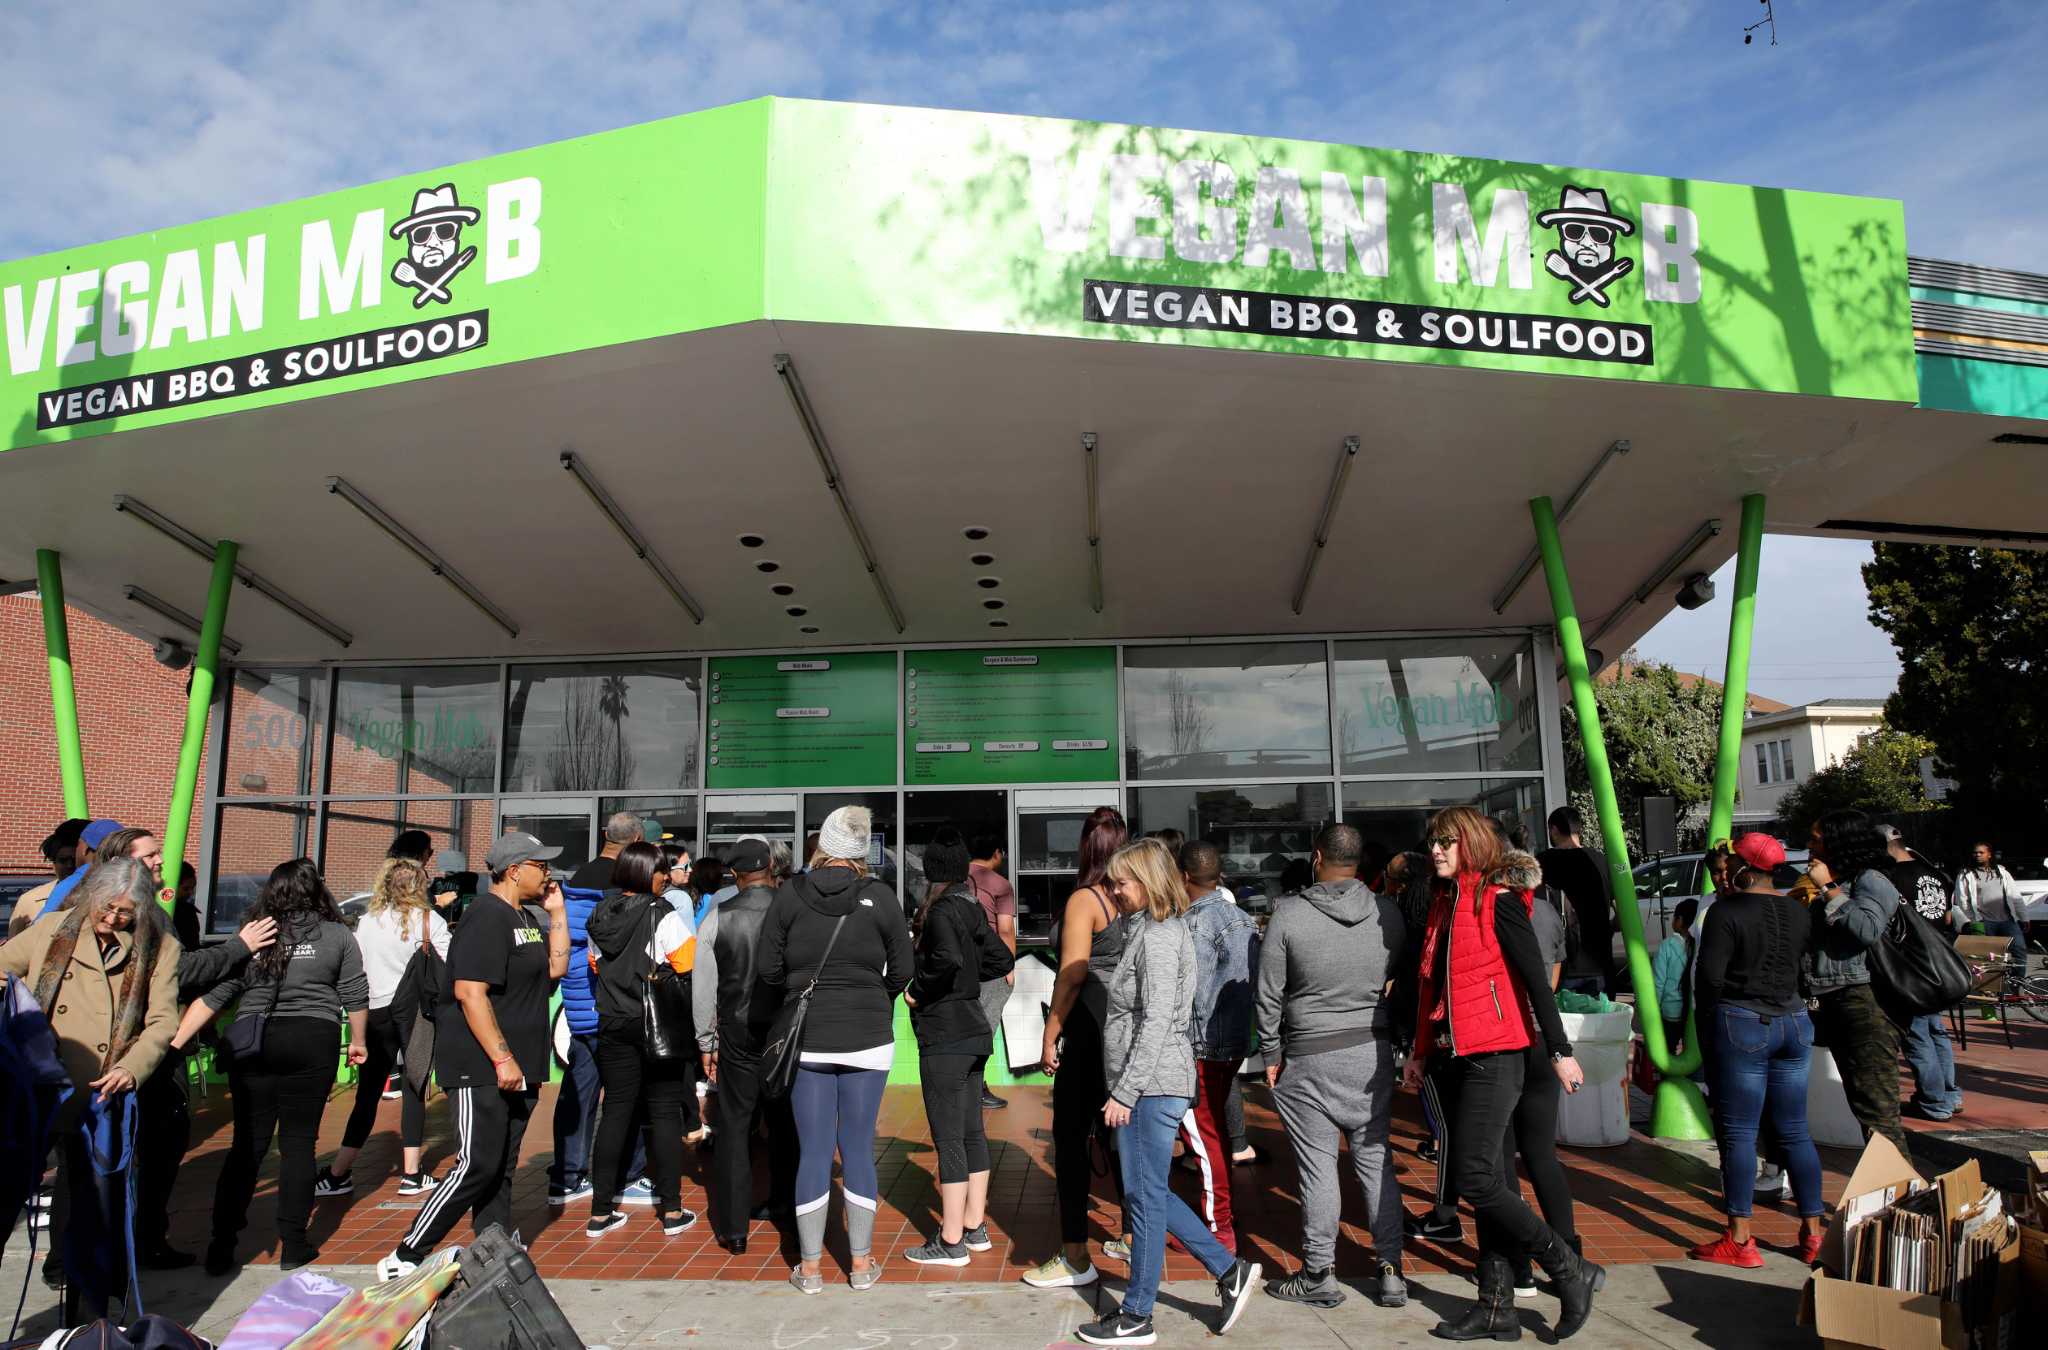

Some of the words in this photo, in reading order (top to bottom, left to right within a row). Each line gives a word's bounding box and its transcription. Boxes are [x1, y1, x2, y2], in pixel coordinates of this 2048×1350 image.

[1028, 150, 1389, 278] VEGAN
[3, 233, 267, 376] VEGAN
[1094, 286, 1251, 327] VEGAN
[1269, 301, 1359, 336] BBQ
[1376, 310, 1405, 339] &
[1420, 311, 1647, 359] SOULFOOD
[44, 378, 154, 423] VEGAN
[168, 362, 236, 401] BBQ
[248, 359, 271, 387] &
[283, 318, 483, 381] SOULFOOD
